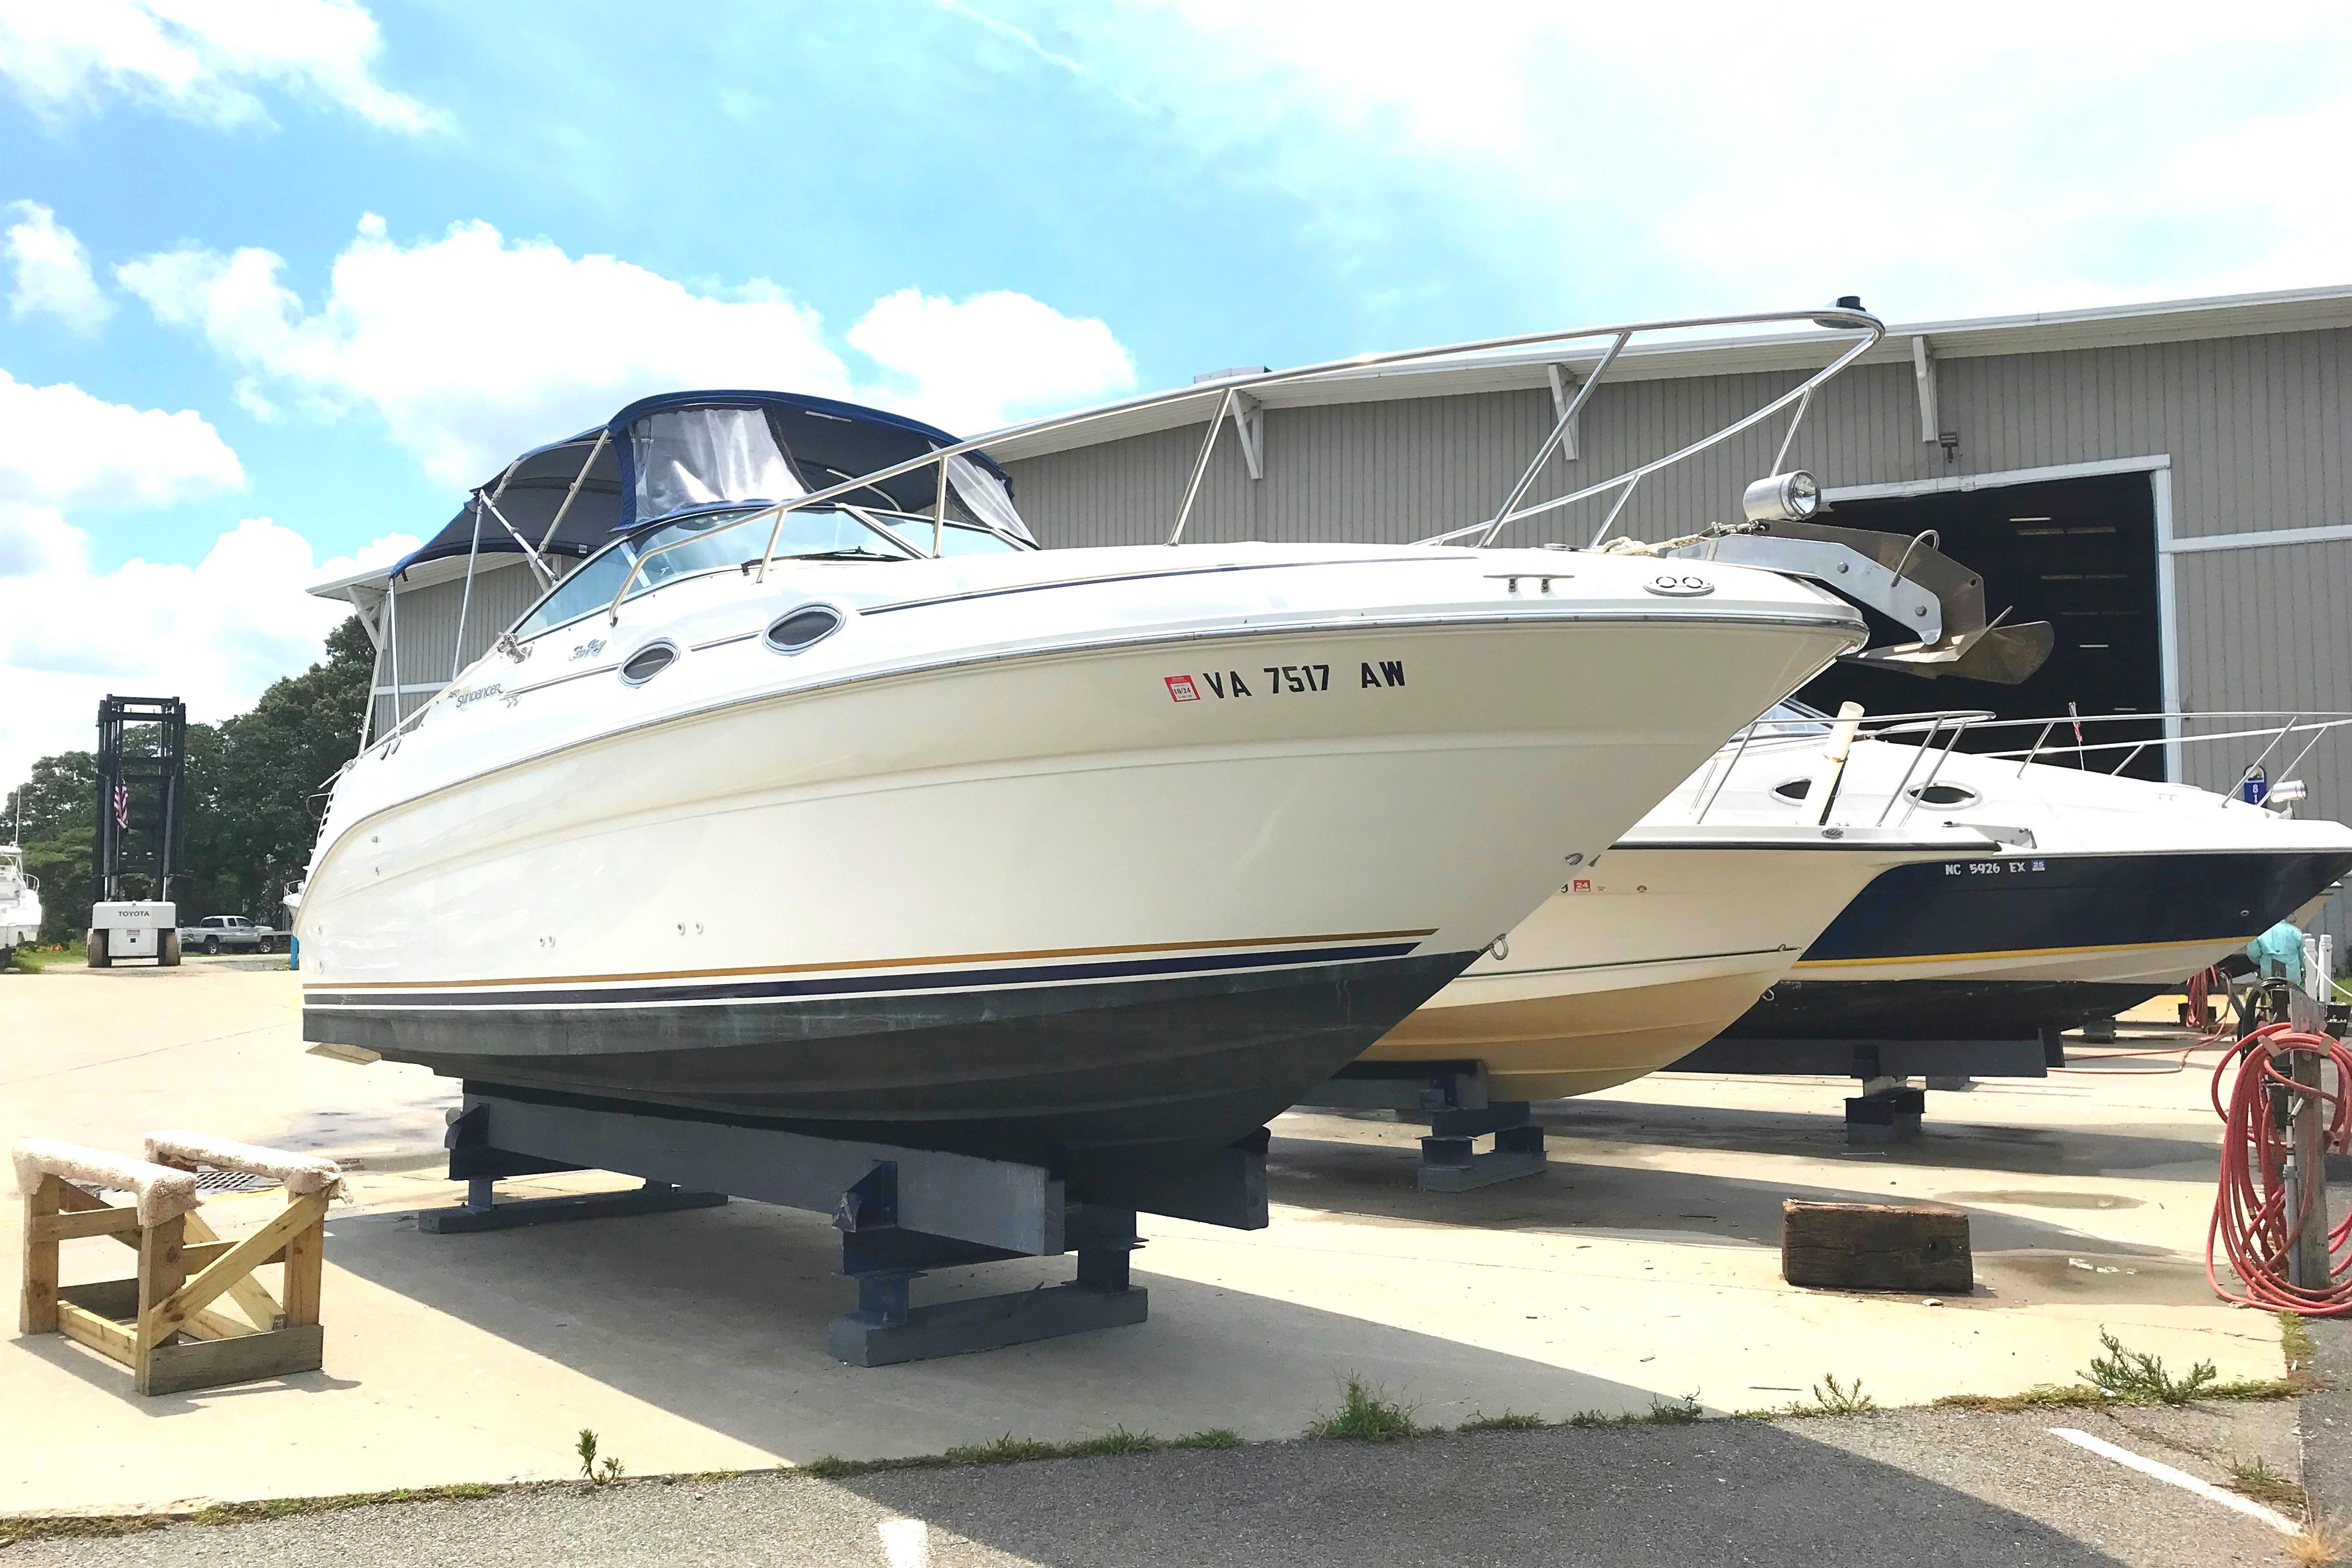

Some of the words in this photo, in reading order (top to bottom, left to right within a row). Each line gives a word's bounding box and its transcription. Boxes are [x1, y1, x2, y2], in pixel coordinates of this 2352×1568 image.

[1203, 671, 1252, 699] VA
[1264, 664, 1329, 694] 7517
[1362, 660, 1405, 688] AW
[1945, 864, 1961, 875] NC
[1969, 863, 2000, 874] 5926
[2009, 862, 2026, 873] EX
